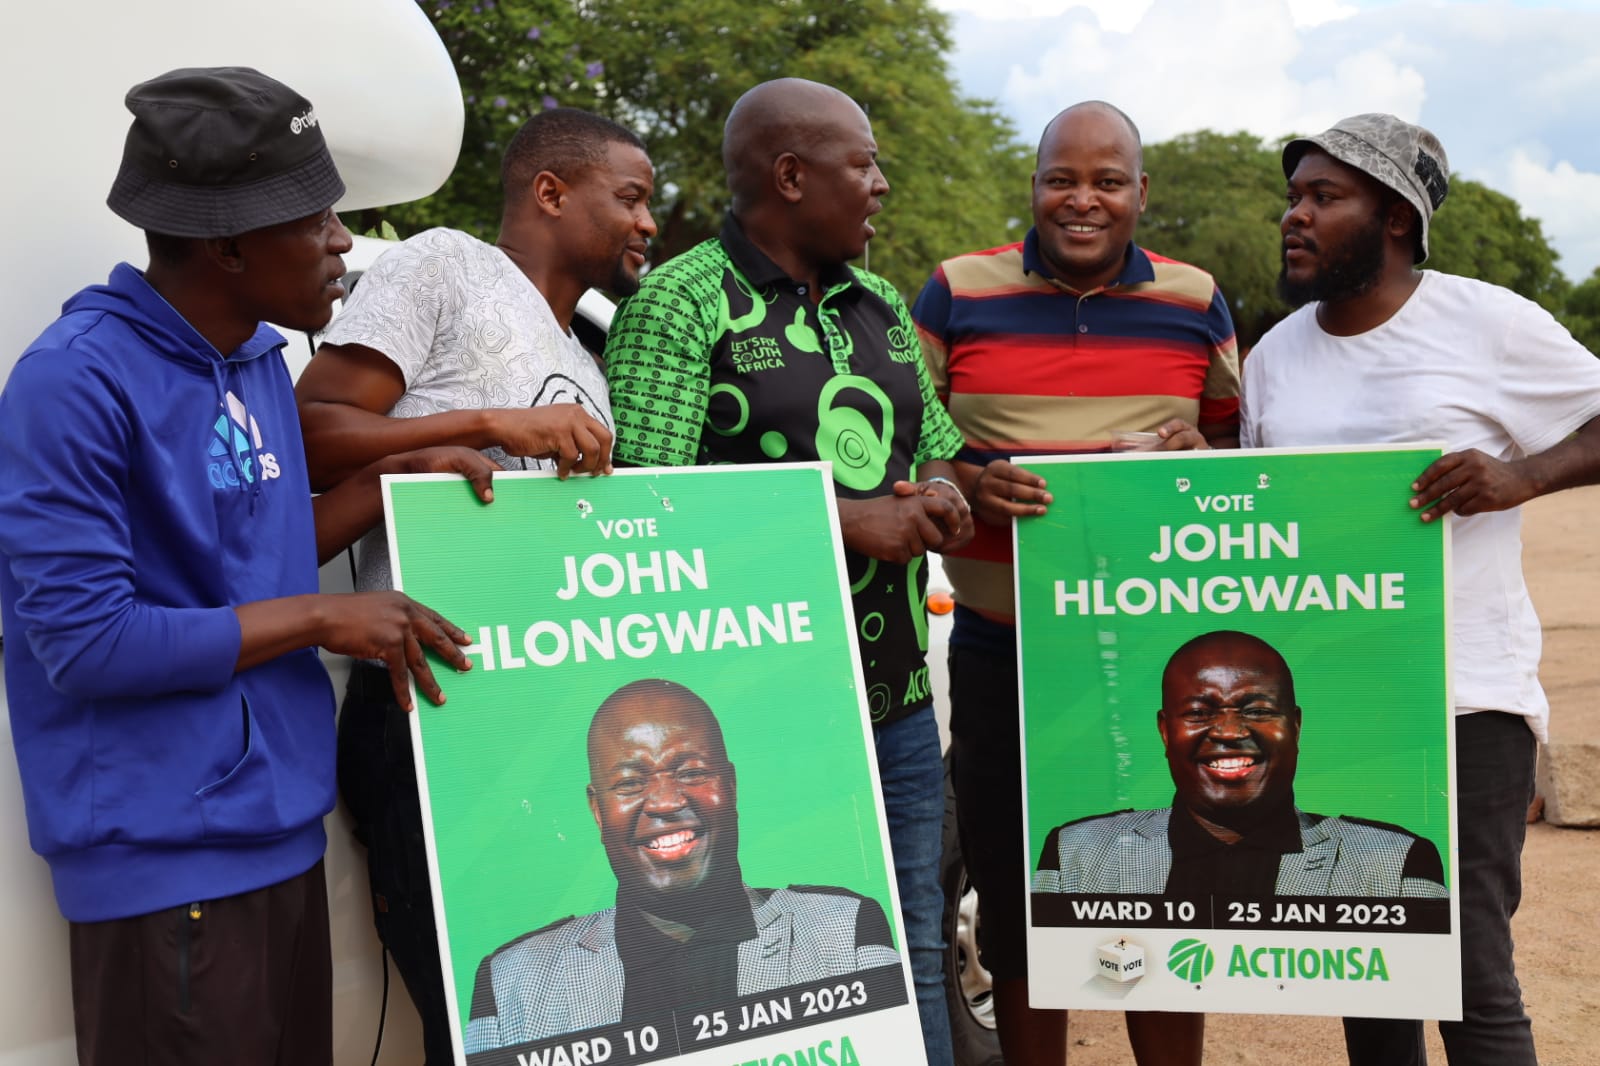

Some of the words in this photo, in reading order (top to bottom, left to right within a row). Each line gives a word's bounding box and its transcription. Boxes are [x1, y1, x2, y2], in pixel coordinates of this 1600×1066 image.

[731, 336, 760, 352] LET'S
[732, 347, 782, 364] SOUTH
[736, 358, 786, 374] AFRICA
[1194, 494, 1255, 513] VOTE
[596, 518, 658, 540] VOTE
[1149, 521, 1299, 563] JOHN
[555, 548, 709, 601] JOHN
[1054, 572, 1406, 616] HLONGWANE
[458, 600, 814, 672] HLONGWANE
[1071, 900, 1152, 921] WARD
[1164, 901, 1196, 922] 10
[1228, 902, 1261, 923] 25
[1270, 902, 1326, 924] JAN
[1335, 904, 1407, 925] 2023
[1099, 958, 1118, 972] VOTE
[1123, 958, 1143, 972] VOTE
[1227, 944, 1390, 982] ACTIONSA
[516, 1036, 612, 1066] WARD
[624, 1026, 659, 1056] 10
[692, 1013, 729, 1041] 25
[738, 996, 793, 1031] JAN
[800, 981, 869, 1018] 2023
